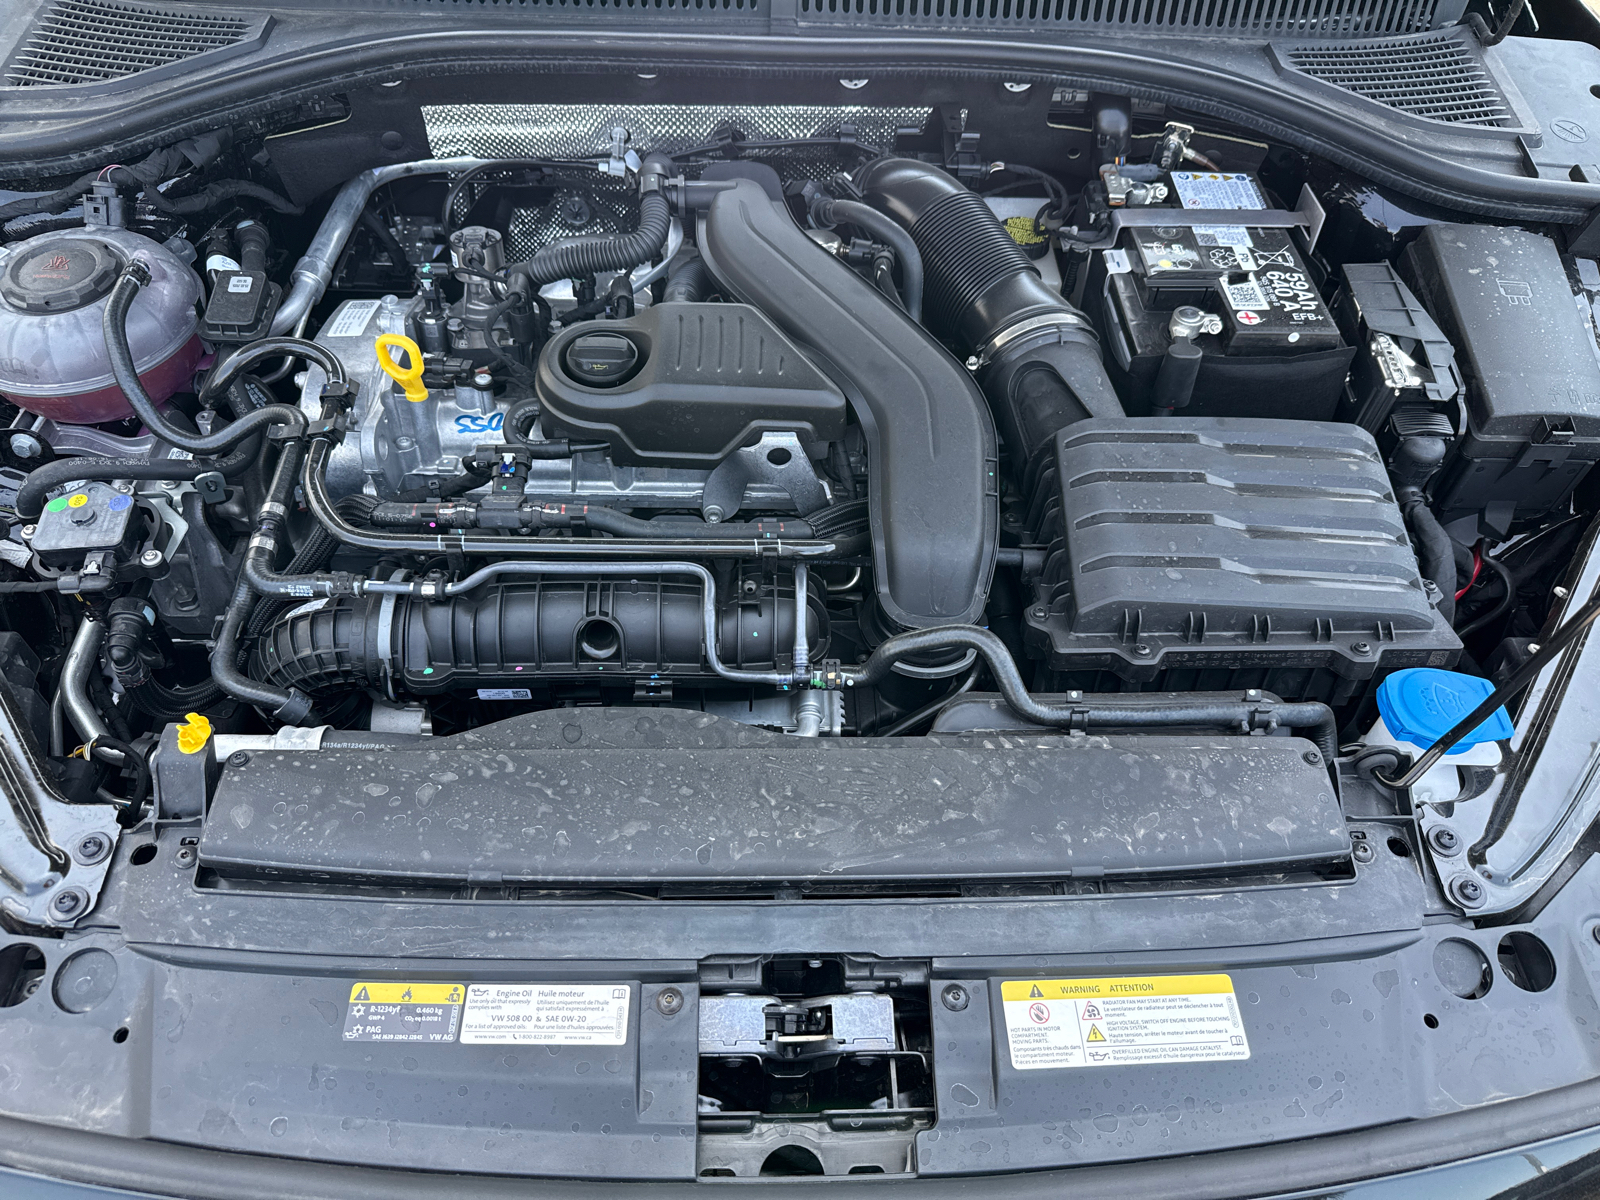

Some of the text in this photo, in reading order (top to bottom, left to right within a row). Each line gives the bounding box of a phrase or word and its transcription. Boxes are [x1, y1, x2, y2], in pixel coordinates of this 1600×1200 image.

[1266, 271, 1294, 297] 640
[1280, 300, 1300, 312] A
[1286, 272, 1318, 310] 59Ah
[1292, 312, 1324, 320] EFB+
[1060, 983, 1154, 994] WARNING ATTENTION
[496, 990, 520, 998] Engine
[370, 1005, 400, 1014] R-1234yf
